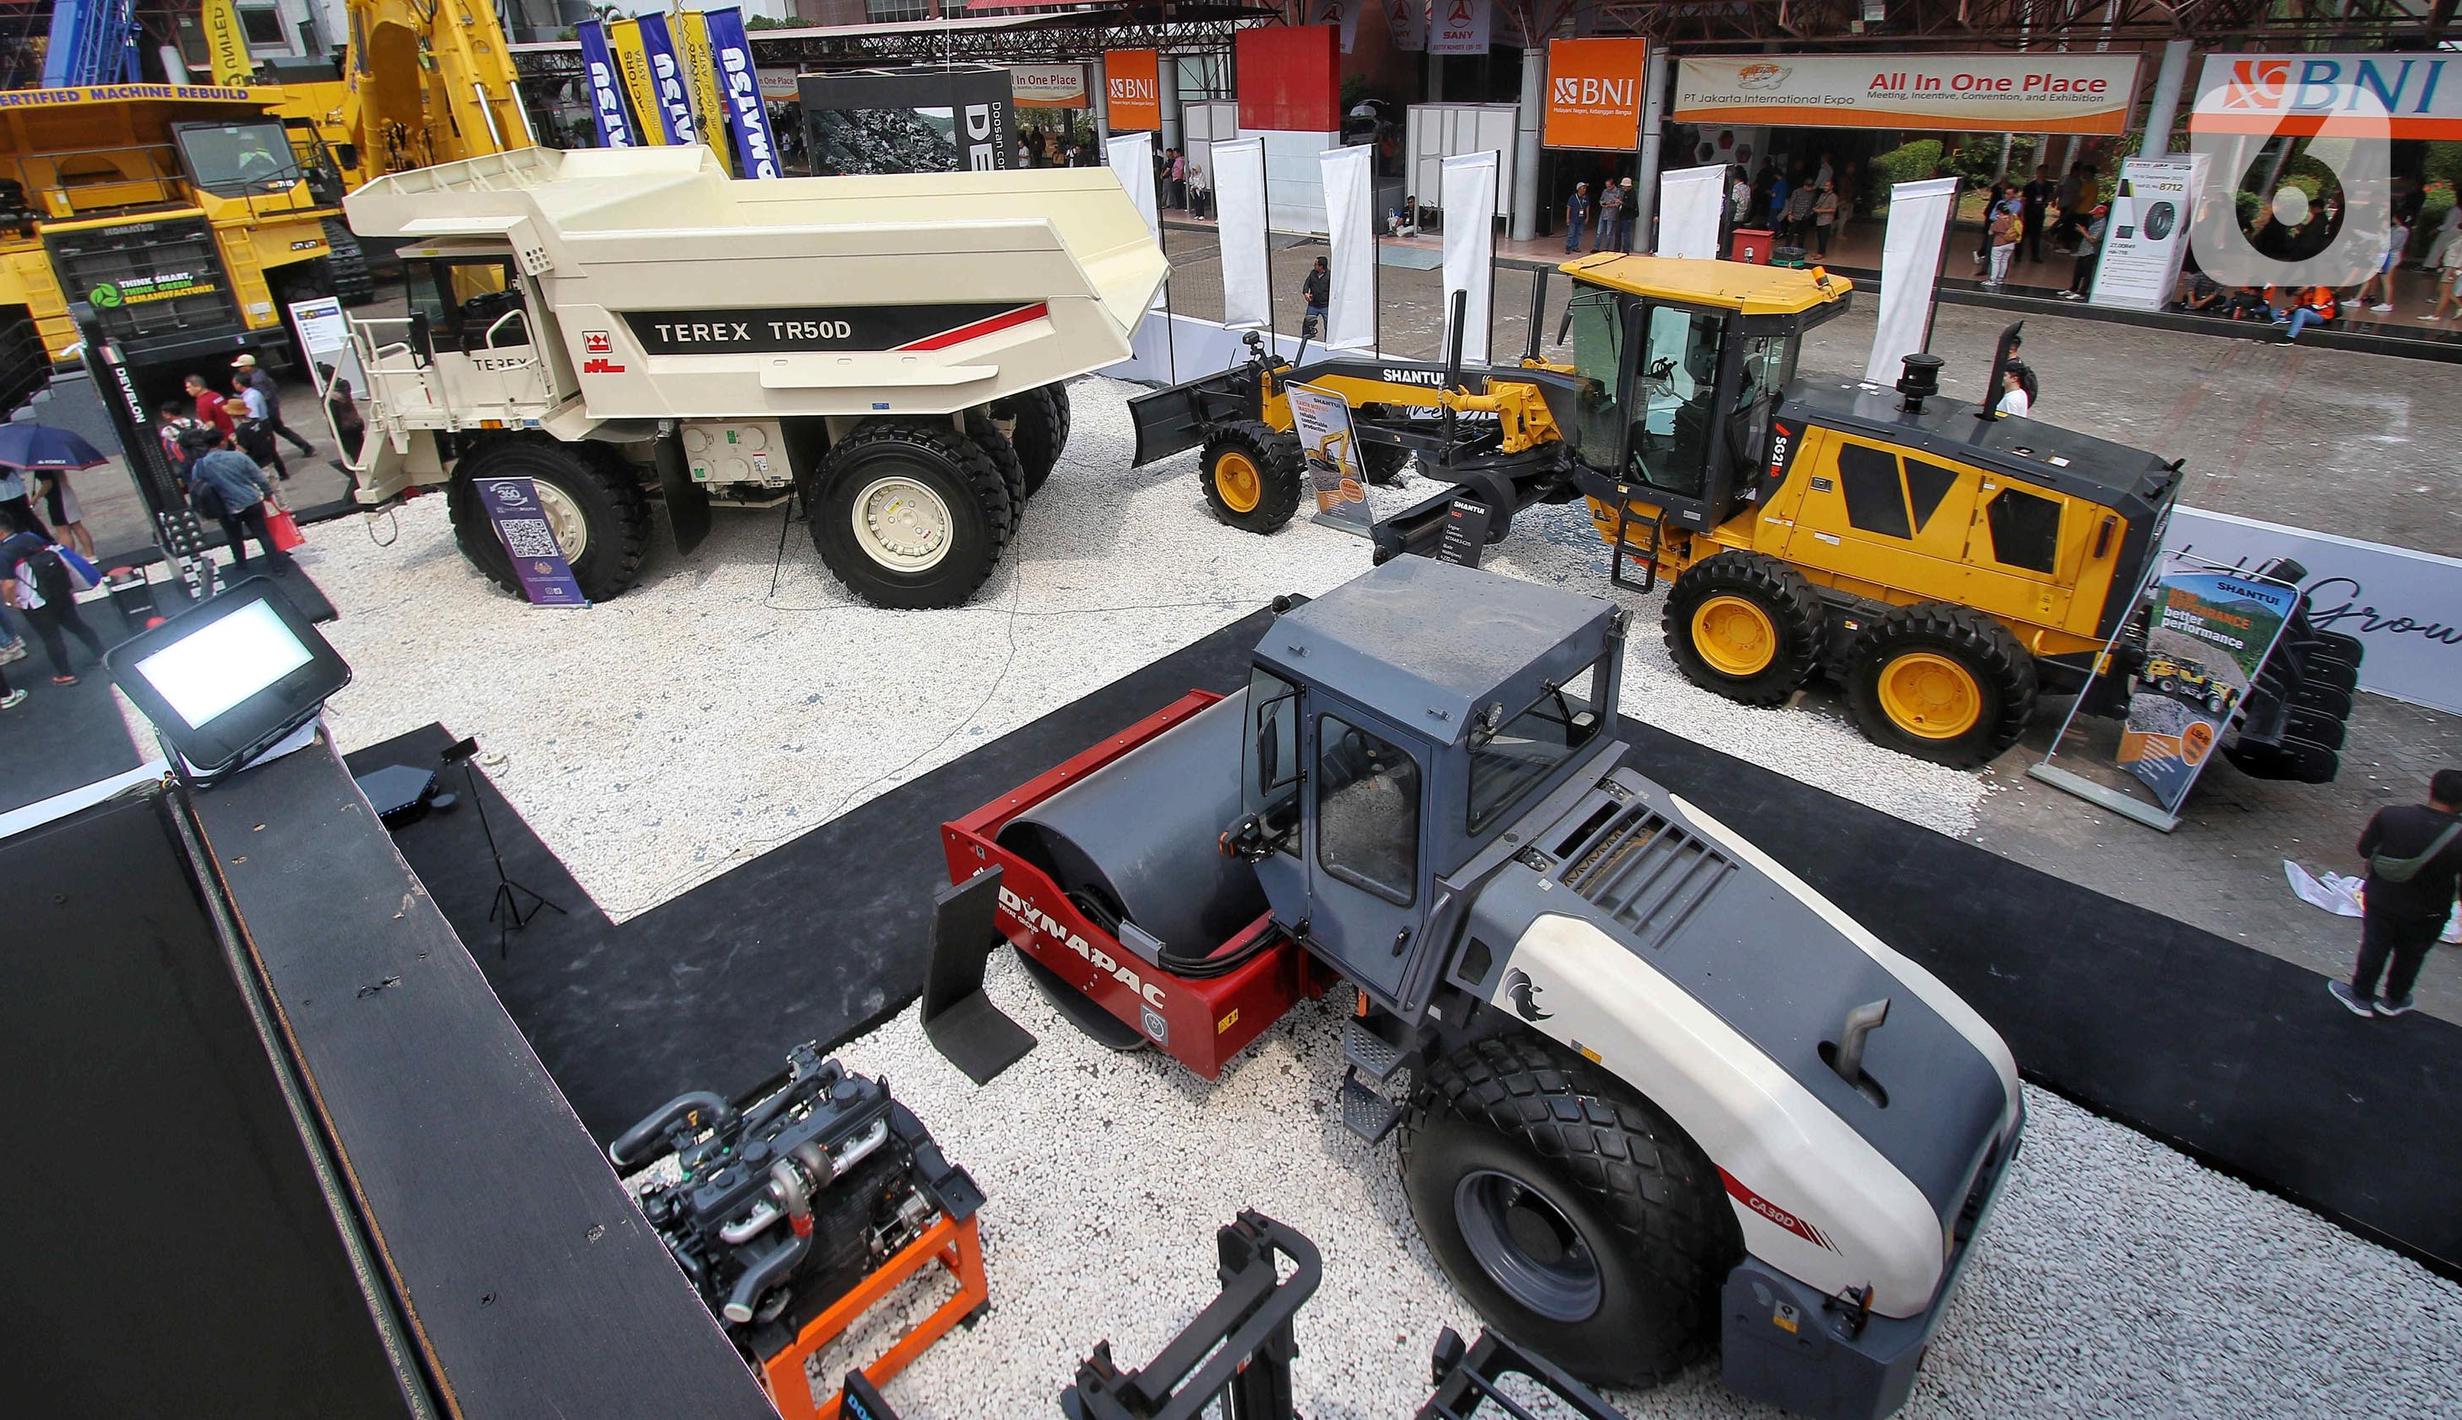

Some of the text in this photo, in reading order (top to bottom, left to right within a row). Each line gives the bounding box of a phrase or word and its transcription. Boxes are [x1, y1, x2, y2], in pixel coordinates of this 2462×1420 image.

[1443, 31, 1474, 40] SANY
[625, 51, 646, 112] ACTORS
[1017, 75, 1026, 85] In
[1028, 75, 1048, 85] One
[1051, 74, 1077, 85] Place
[1126, 79, 1154, 98] BNI
[1869, 73, 2108, 93] All In One Place
[2289, 60, 2447, 113] BNI
[0, 86, 249, 106] ERTIFIED MACHINE REBUILD
[653, 53, 696, 146] ATSU
[1581, 78, 1635, 106] BNI
[1699, 94, 1742, 103] Jakarta
[1744, 95, 1821, 104] International
[1824, 95, 1855, 105] Expo
[1867, 91, 1908, 100] Meeting,
[1911, 92, 1958, 100] Incentive,
[1961, 92, 2021, 101] Convention,
[2049, 94, 2104, 103] Exhibition
[590, 62, 628, 148] ATSU
[992, 102, 1003, 149] Doosan
[2159, 183, 2184, 192] 8712
[117, 272, 194, 289] THINK SMART,
[122, 280, 193, 296] THINK GREEN
[654, 320, 851, 342] TEREX TR50D
[472, 358, 531, 372] TEREX
[1383, 368, 1445, 385] SHANTUI
[115, 366, 147, 424] DEVELON
[1453, 500, 1486, 515] SHANTUI
[2217, 581, 2280, 606] SHANTUI
[2163, 605, 2205, 626] better
[2161, 616, 2245, 650] performance
[998, 885, 1166, 1010] DYNAPAC
[1749, 1198, 1796, 1227] CA30D
[847, 1393, 874, 1420] DO
